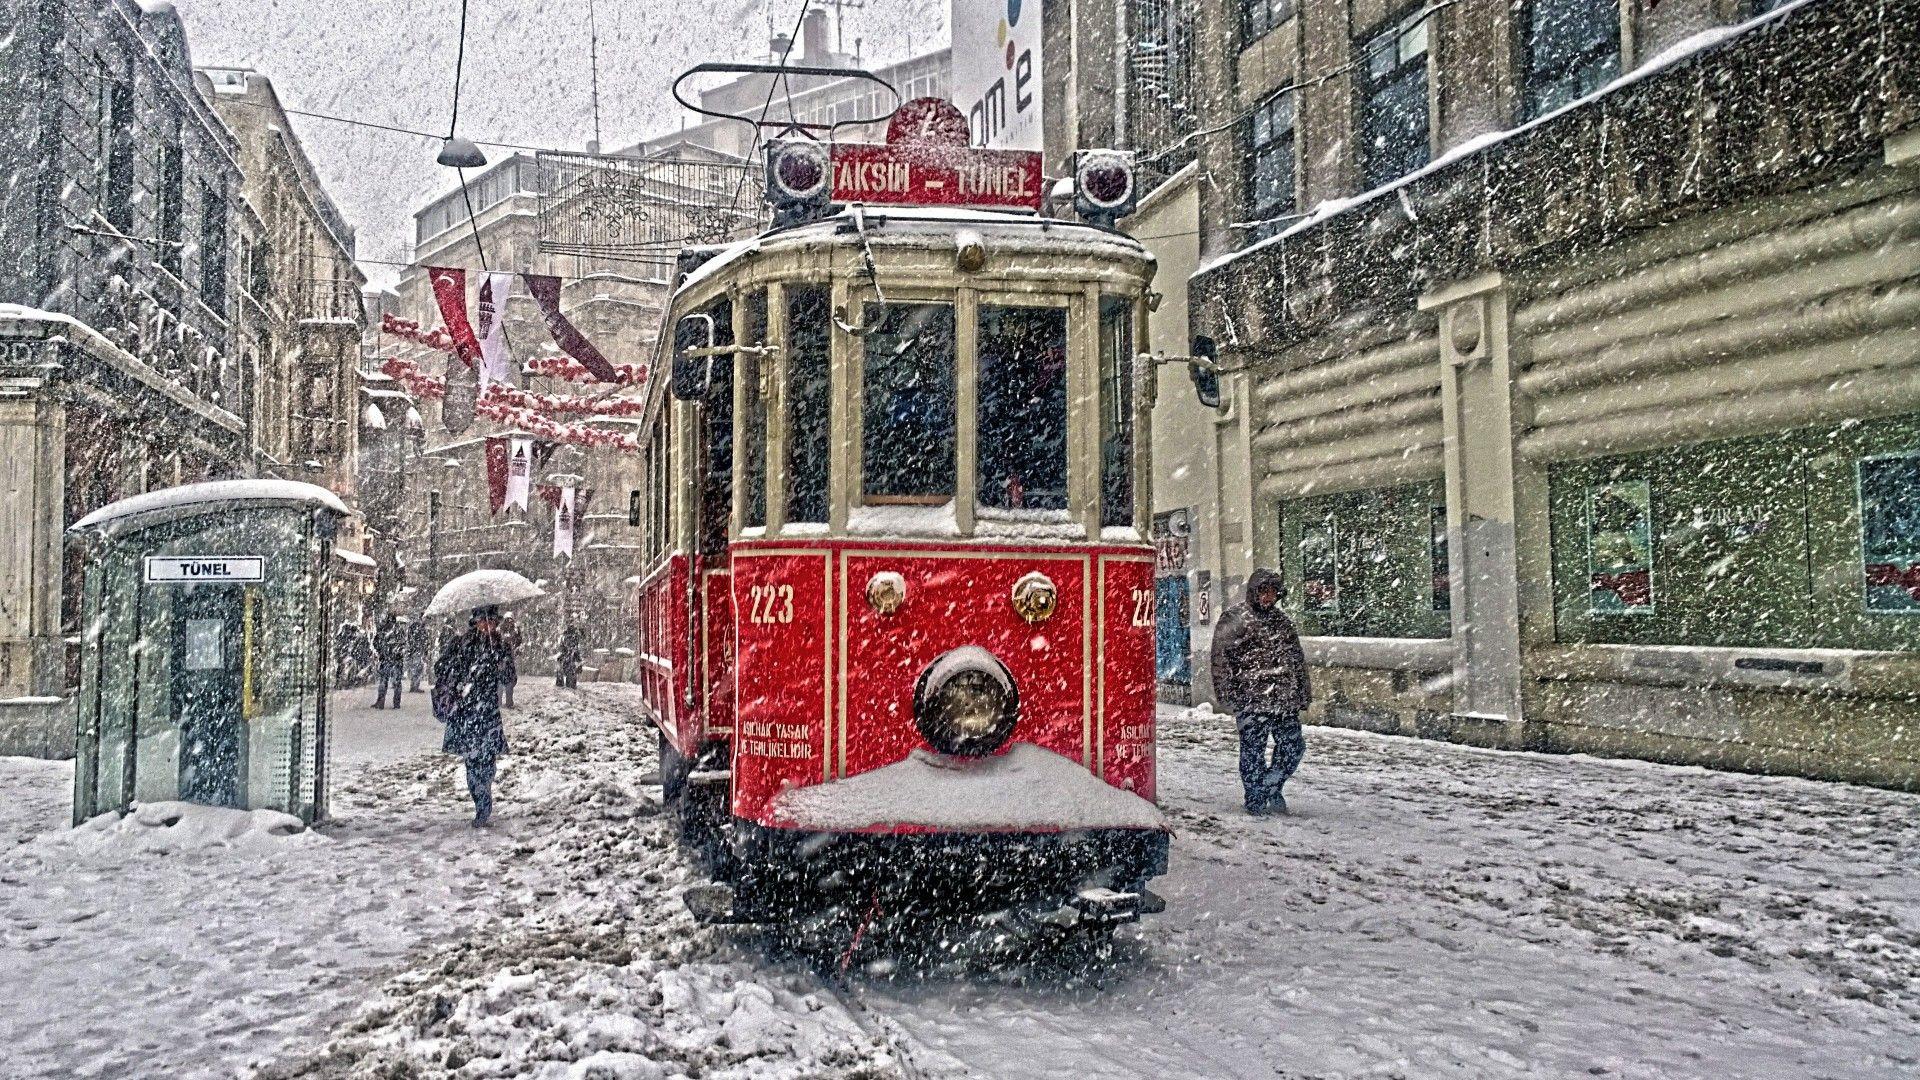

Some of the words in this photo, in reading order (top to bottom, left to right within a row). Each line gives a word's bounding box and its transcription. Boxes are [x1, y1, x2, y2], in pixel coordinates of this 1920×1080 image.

[180, 562, 231, 576] TÜNEL
[750, 584, 795, 624] 223
[776, 723, 809, 740] YASAK
